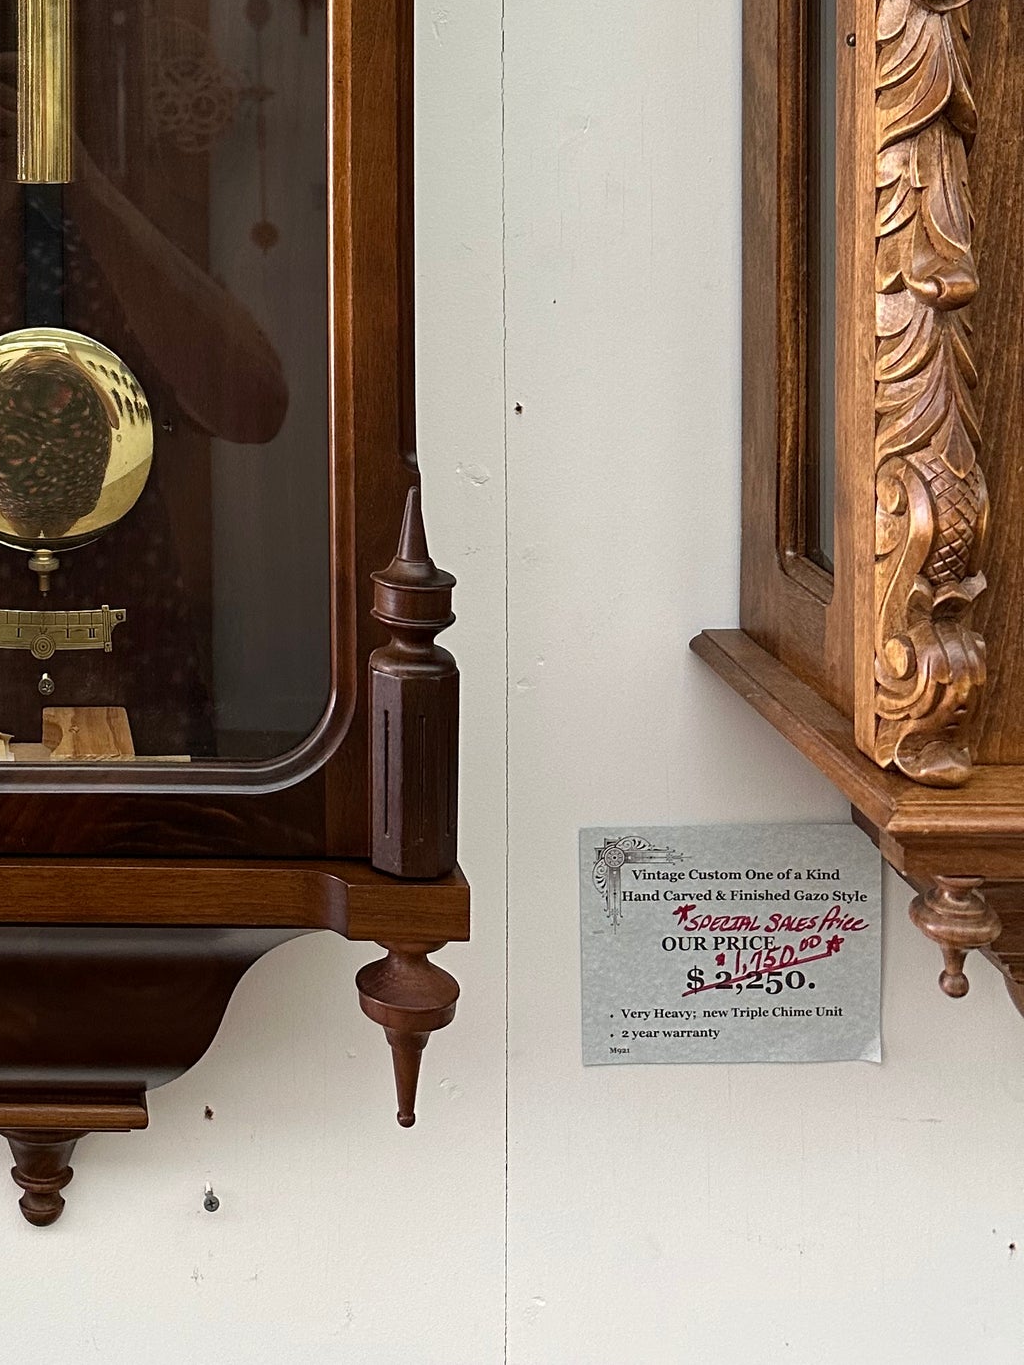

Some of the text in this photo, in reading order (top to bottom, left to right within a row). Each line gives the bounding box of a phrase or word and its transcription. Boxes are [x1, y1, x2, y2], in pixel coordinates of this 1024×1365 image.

[632, 869, 840, 882] Vintage Custom One of a Kind
[622, 890, 868, 904] Hand Carved & Finished Gazo Style
[764, 914, 820, 932] SALES
[817, 905, 869, 933] Price
[662, 937, 708, 951] OUR
[621, 1007, 843, 1020] Very Heavy; new Triple Chime Unit
[632, 1029, 659, 1040] year
[662, 1028, 720, 1040] warranty
